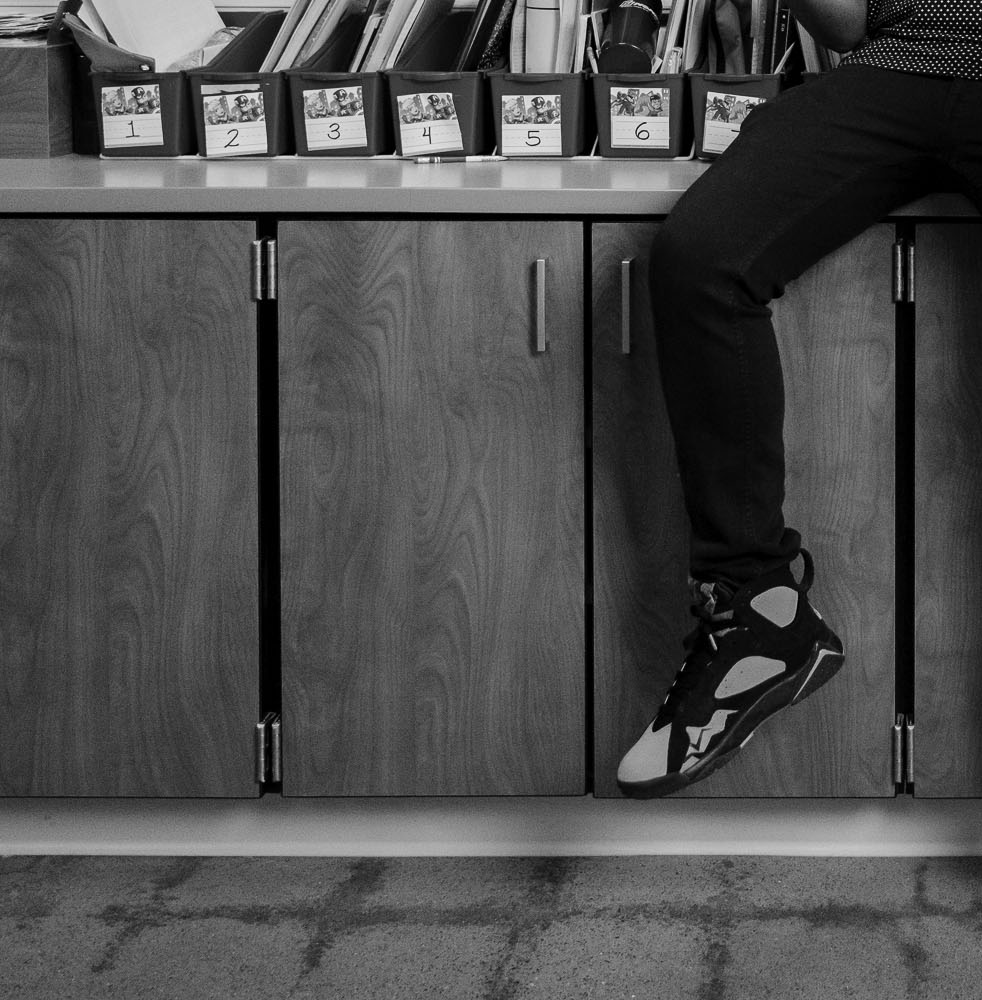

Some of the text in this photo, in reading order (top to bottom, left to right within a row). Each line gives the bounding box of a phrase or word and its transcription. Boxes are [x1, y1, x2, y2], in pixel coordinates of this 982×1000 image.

[126, 120, 141, 139] 1
[224, 128, 239, 149] 2
[327, 123, 341, 140] 3
[422, 126, 432, 145] 4
[525, 130, 541, 147] 5
[635, 121, 650, 141] 6
